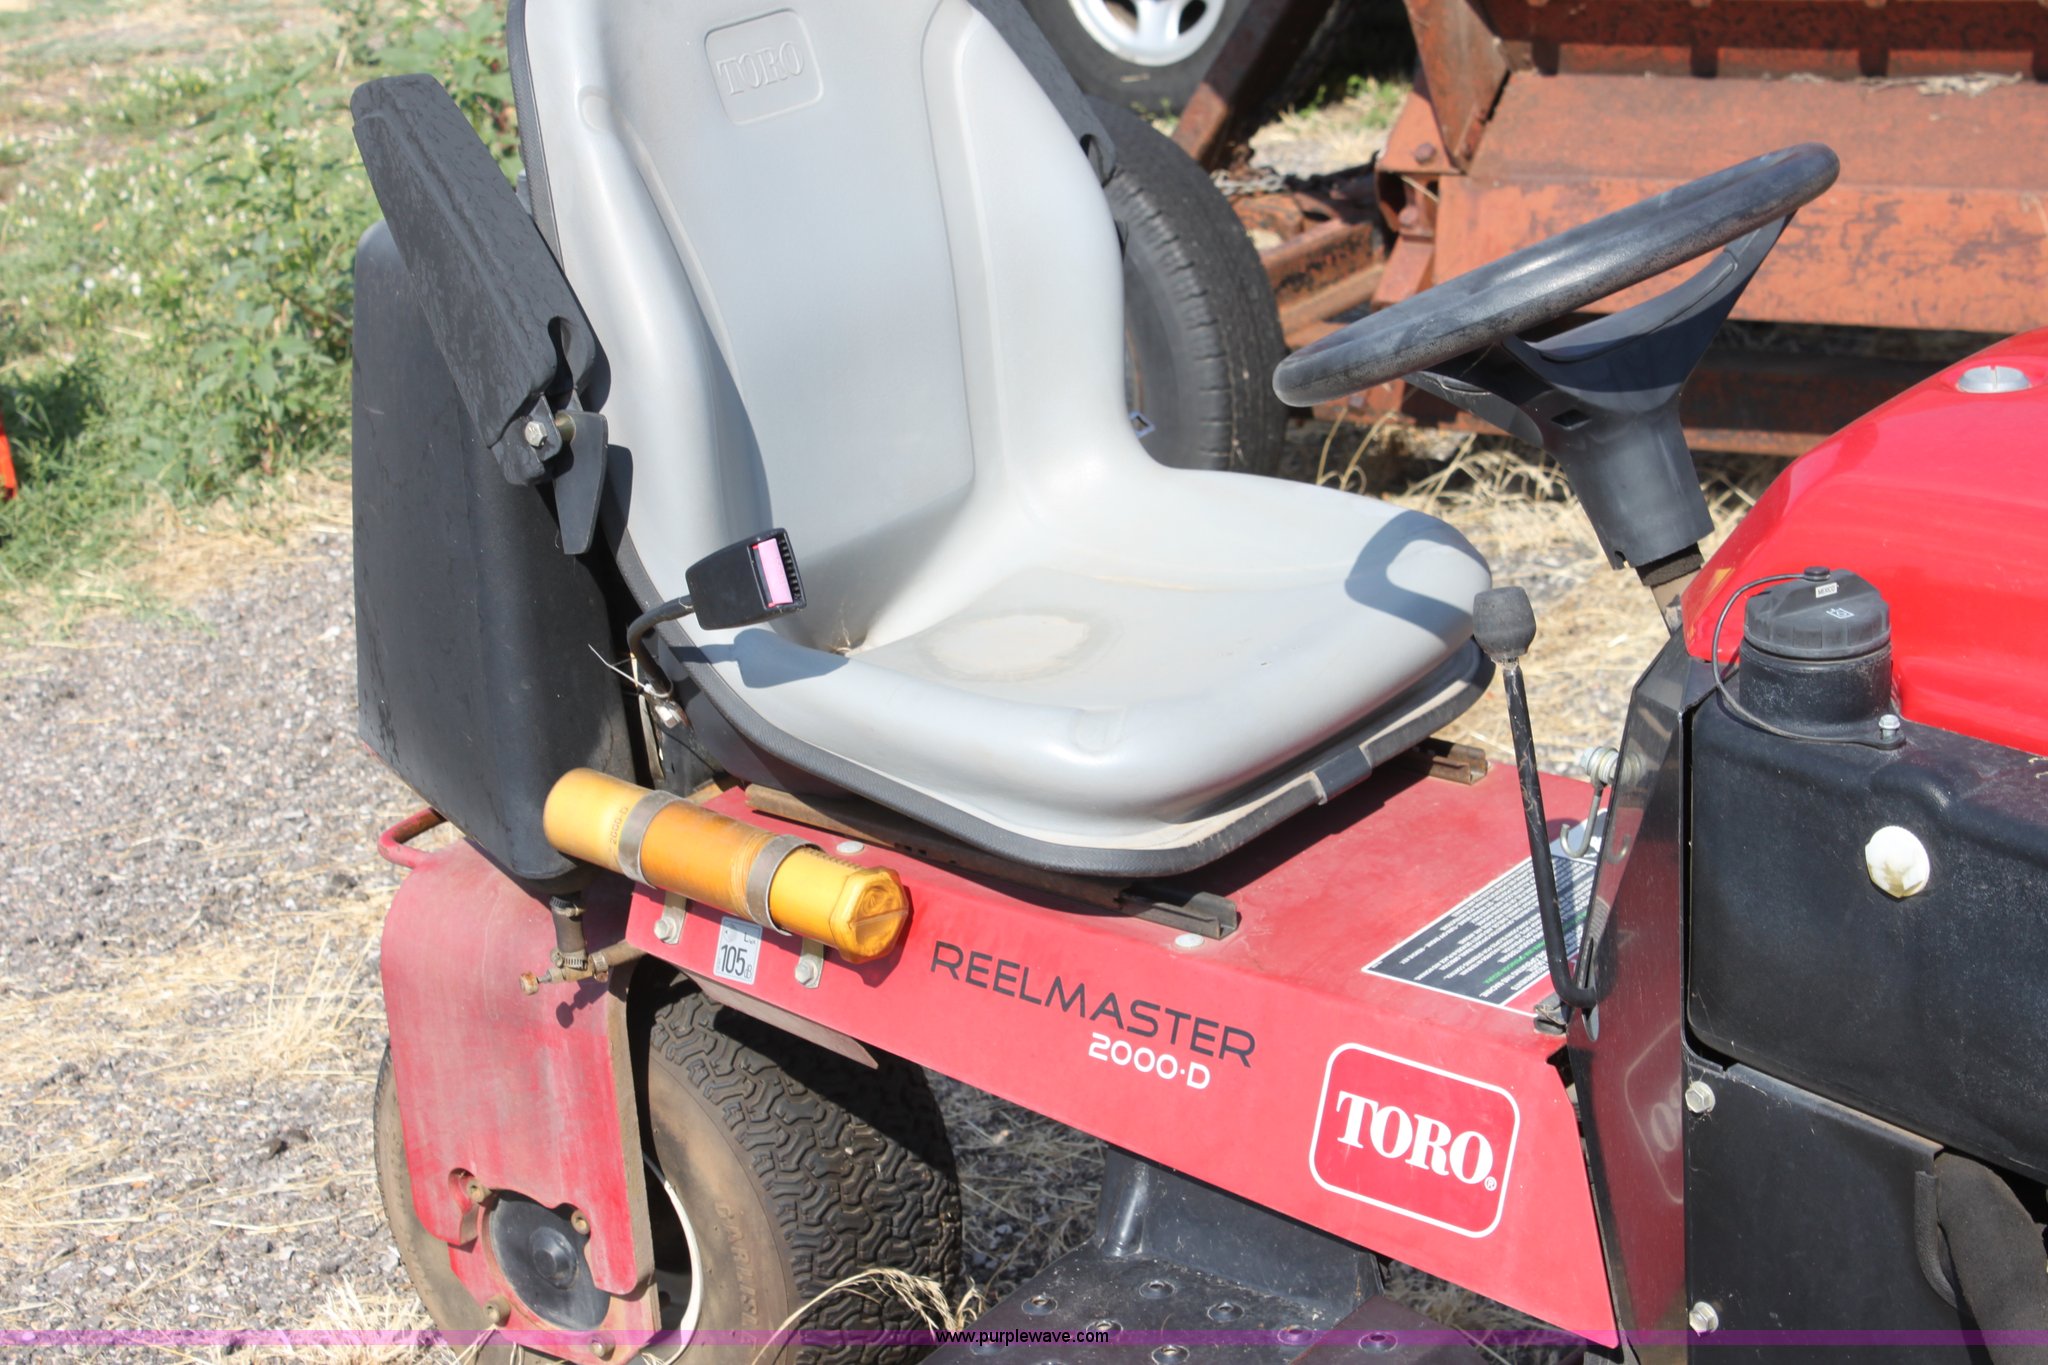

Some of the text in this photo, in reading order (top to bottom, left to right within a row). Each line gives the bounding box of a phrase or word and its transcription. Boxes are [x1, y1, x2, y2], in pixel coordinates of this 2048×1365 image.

[715, 41, 804, 95] TORO
[721, 944, 748, 976] 105
[930, 940, 1256, 1068] REELMASTER
